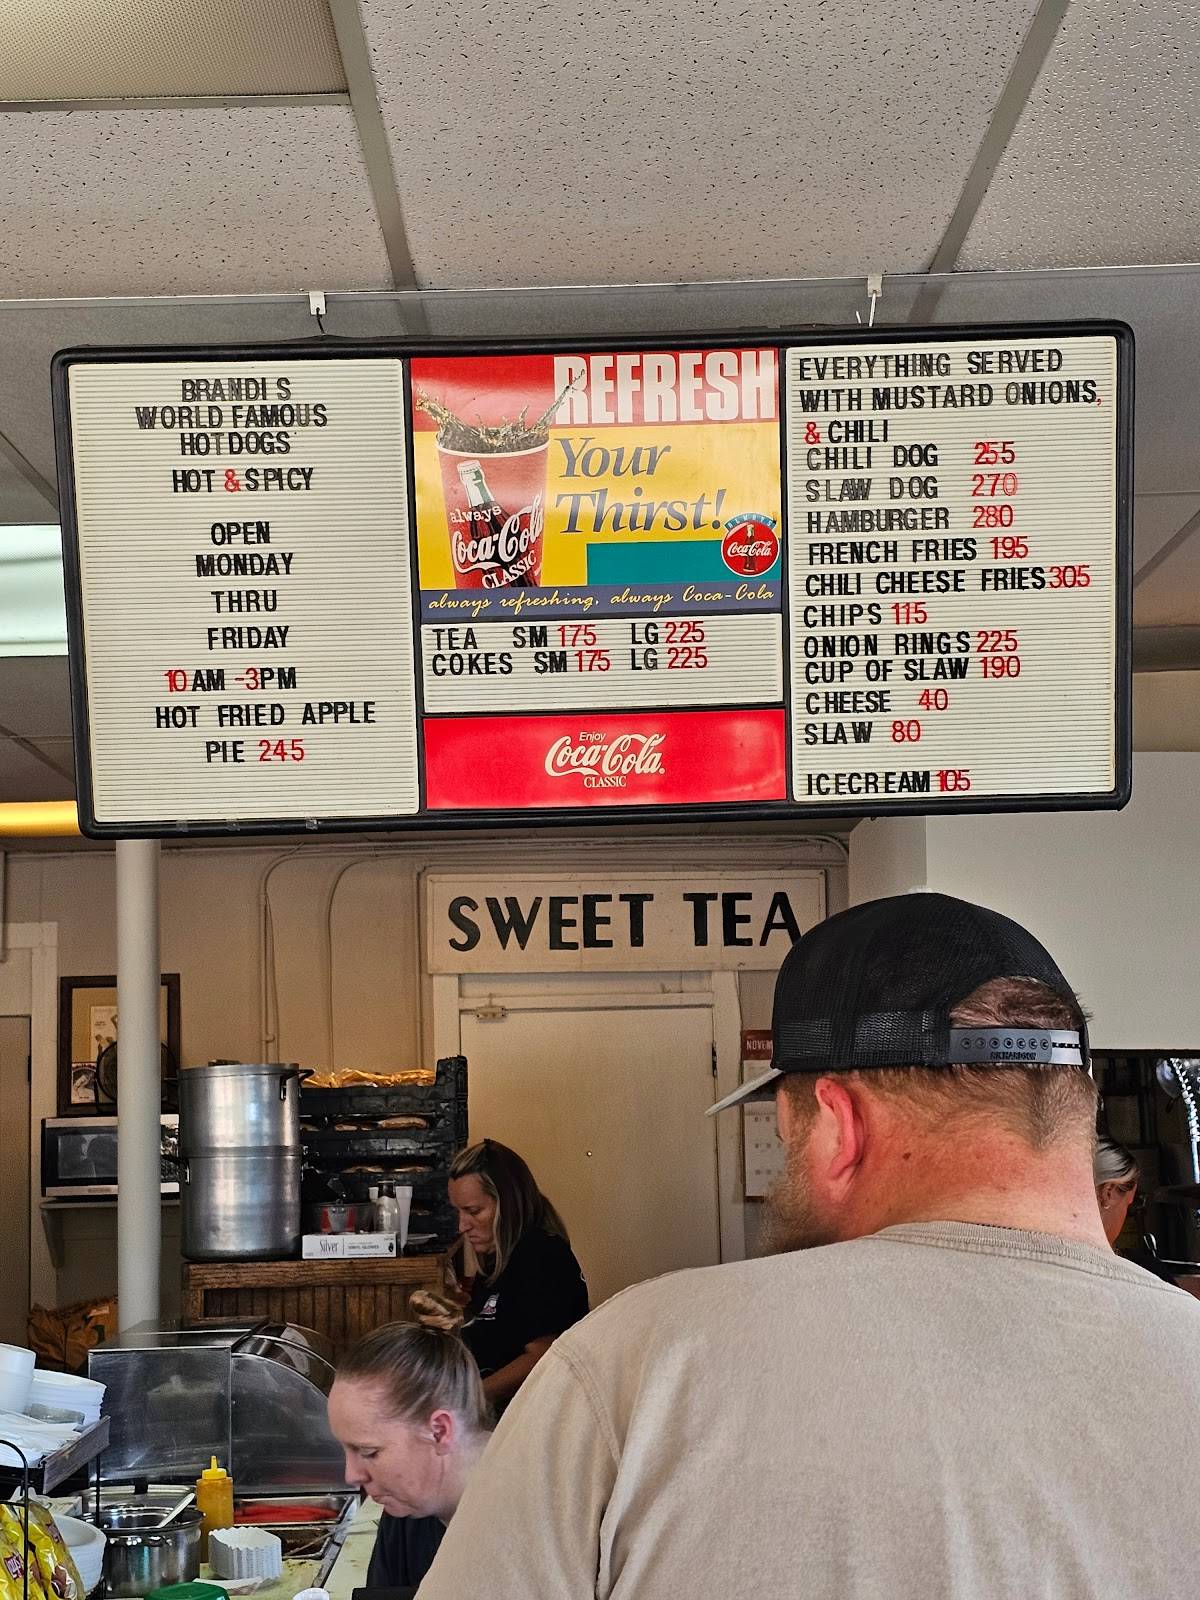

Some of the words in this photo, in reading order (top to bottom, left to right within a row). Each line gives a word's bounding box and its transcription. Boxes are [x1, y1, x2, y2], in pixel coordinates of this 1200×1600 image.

[799, 353, 950, 381] EVERYTHING
[967, 348, 1062, 375] SERVED
[181, 377, 267, 402] BRANDI
[553, 350, 776, 425] REFRESH
[800, 388, 862, 413] WITH
[872, 383, 993, 410] MUSTARD
[1005, 379, 1102, 406] ONIONS,
[135, 405, 223, 429] WORLD
[232, 403, 328, 428] FAMOUS
[804, 421, 821, 444] &
[827, 419, 888, 444] CHILI
[554, 436, 671, 478] Your
[806, 446, 872, 471] CHILI
[893, 443, 938, 468] DOG
[974, 441, 1016, 465] 255
[172, 469, 216, 493] HOT
[224, 468, 241, 492] &
[245, 467, 314, 491] SPICY
[805, 478, 872, 502] SLAW
[889, 475, 938, 499] DOG
[971, 472, 1018, 497] 270
[450, 505, 502, 523] always
[555, 486, 727, 534] Thirst!
[807, 507, 950, 533] HAMBURGER
[972, 504, 1014, 529] 280
[210, 521, 271, 546] OPEN
[727, 540, 773, 557] Coca-Cola
[808, 540, 898, 565] FRENCH
[911, 538, 977, 563] FRIES
[989, 536, 1029, 560] 195
[195, 553, 294, 577] MONDAY
[482, 550, 537, 589] CLASSIC
[805, 572, 862, 597] CHILI
[875, 569, 966, 595] CHEESE
[981, 566, 1046, 592] FRIES
[1049, 565, 1091, 589] 305
[211, 589, 277, 613] THRU
[428, 592, 491, 617] always
[610, 590, 674, 611] always
[682, 585, 774, 601] Coca-Cola
[803, 602, 882, 628] CHIPS
[891, 602, 928, 625] 115
[207, 625, 290, 650] FRIDAY
[432, 628, 478, 651] TEA
[512, 626, 548, 648] SM
[557, 624, 597, 647] 175
[630, 622, 659, 645] LG
[664, 621, 705, 644] 225
[804, 634, 878, 658] ONION
[895, 630, 971, 655] RINGS
[976, 630, 1018, 653] 225
[432, 653, 513, 676] COKES
[534, 651, 568, 674] SM
[574, 650, 611, 672] 175
[630, 649, 659, 671] LG
[667, 647, 709, 669] 225
[805, 660, 853, 685] CUP
[865, 659, 893, 683] OF
[904, 657, 969, 681] SLAW
[978, 655, 1021, 679] 190
[155, 705, 200, 728] HOT
[217, 703, 285, 727] FRIED
[301, 701, 376, 725] APPLE
[805, 690, 891, 715] CHEESE
[918, 688, 949, 711] 40
[579, 731, 606, 743] Enjoy
[804, 721, 873, 745] SLAW
[891, 719, 921, 743] 80
[205, 740, 245, 763] PIE
[258, 739, 305, 762] 245
[584, 776, 627, 788] CLASSIC
[935, 769, 971, 792] 105
[448, 893, 654, 952] SWEET
[683, 891, 802, 947] TEA
[320, 1238, 339, 1253] Silver
